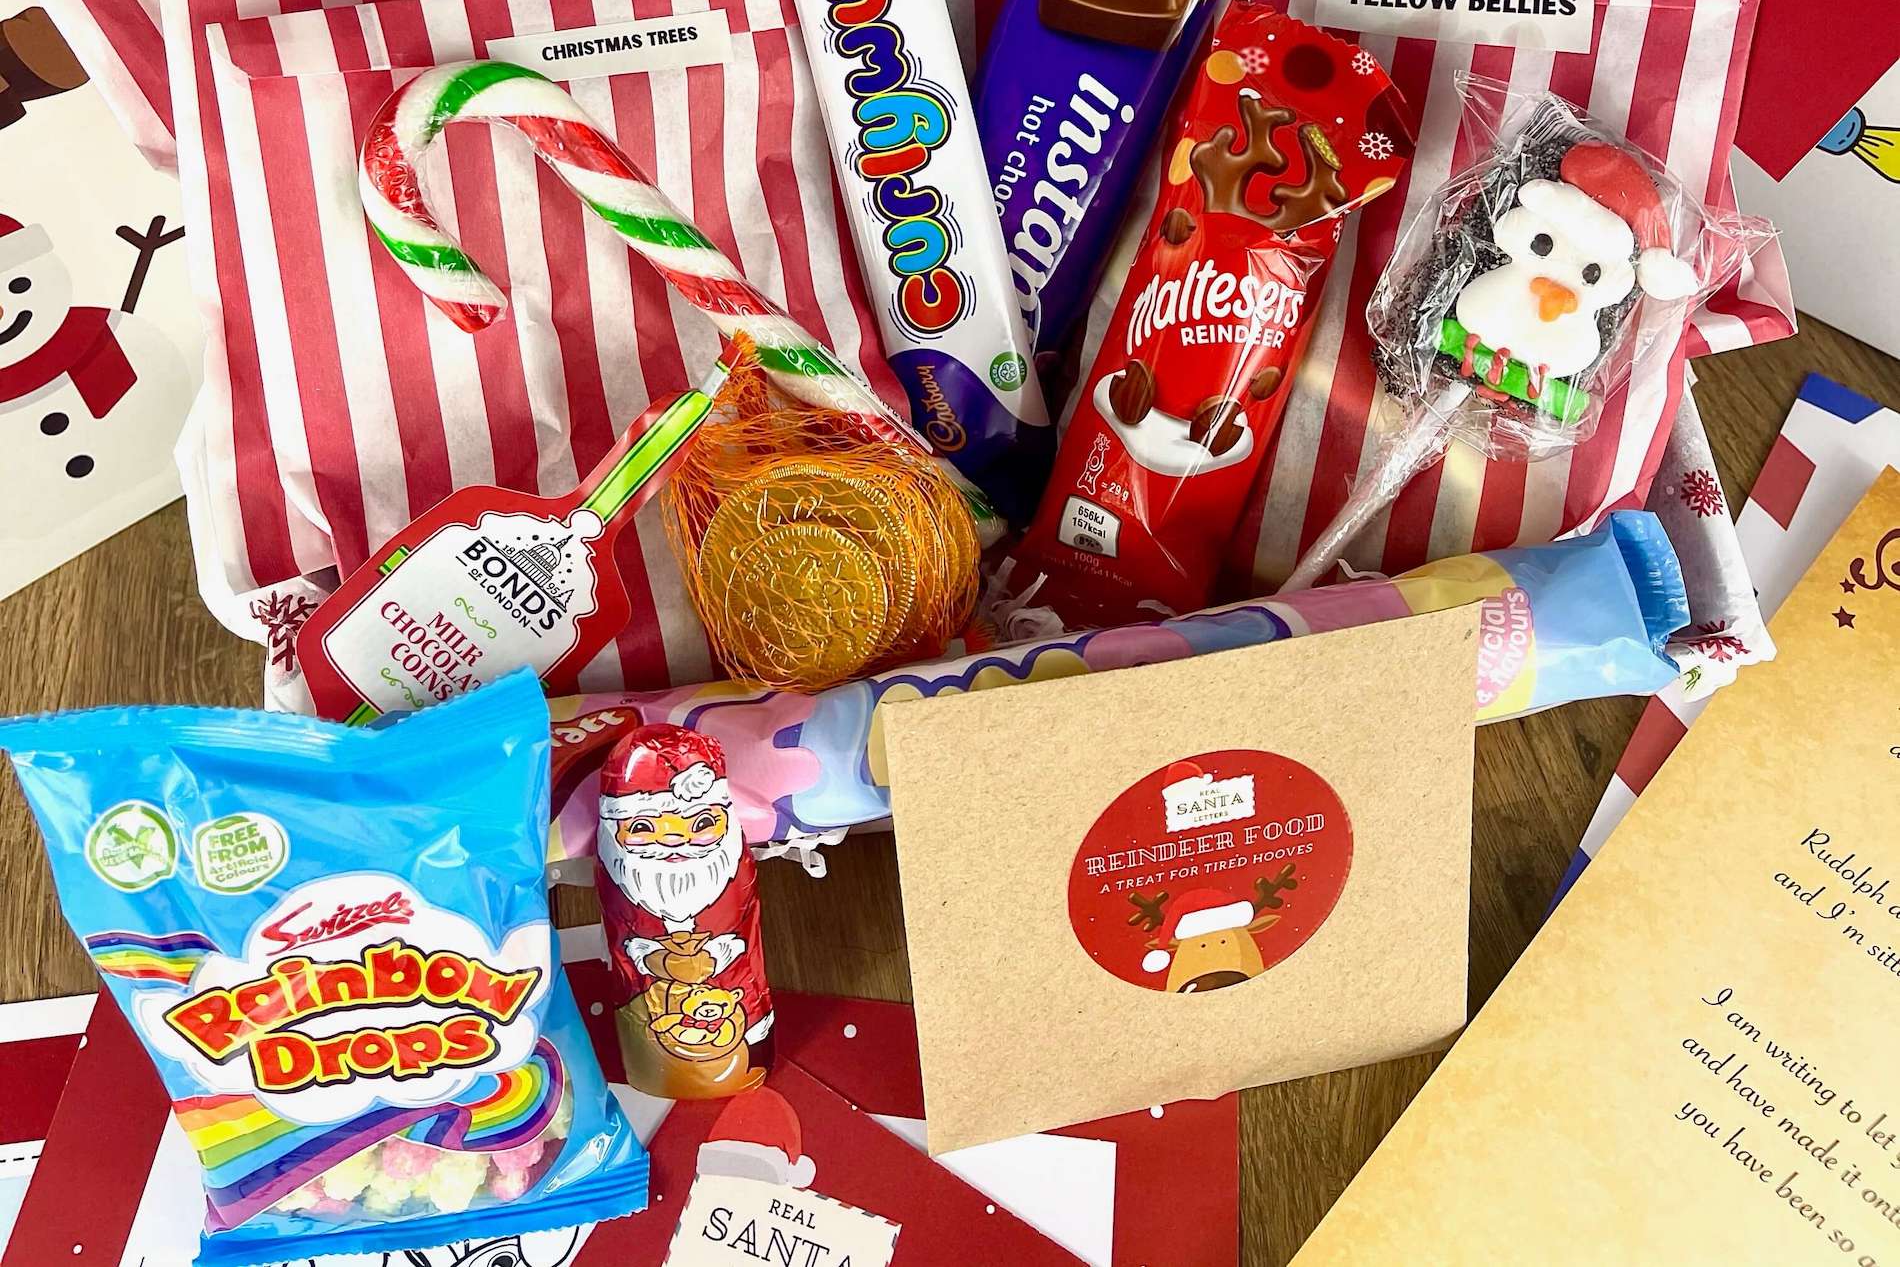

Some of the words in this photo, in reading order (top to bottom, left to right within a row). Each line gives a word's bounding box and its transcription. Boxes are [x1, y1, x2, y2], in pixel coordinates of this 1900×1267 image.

[542, 34, 642, 61] CHRISTMAS
[647, 27, 698, 46] TREES
[1016, 94, 1056, 147] hot
[1008, 72, 1135, 322] instan
[1181, 324, 1285, 349] REINDEER
[916, 365, 967, 452] Cadbury
[1084, 471, 1094, 484] 1x
[1078, 505, 1104, 525] 656kJ
[462, 539, 563, 631] BONDS
[502, 545, 515, 556] 18
[547, 582, 560, 595] 95
[471, 568, 483, 580] OF
[479, 577, 531, 628] LONDON
[427, 612, 484, 667] MILK
[390, 643, 453, 701] COINS
[1176, 792, 1244, 816] SANTA
[1193, 811, 1229, 823] LETTERS
[207, 836, 268, 863] FROM
[208, 822, 260, 847] FREE
[1085, 831, 1235, 876] REINDEER
[1244, 813, 1325, 846] FOOD
[215, 863, 270, 883] Colours
[1100, 884, 1111, 894] A
[1116, 872, 1165, 891] TREAT
[1169, 866, 1199, 880] FOR
[1204, 857, 1248, 874] TIRED
[1252, 843, 1314, 864] HOOVES
[1800, 828, 1890, 905] Rudolph
[1774, 871, 1826, 906] and
[1815, 902, 1864, 946] I'm
[165, 939, 540, 1062] Rainbow
[253, 1015, 498, 1092] Drops
[1701, 988, 1733, 1006] I
[1727, 1012, 1761, 1043] am
[1765, 1040, 1836, 1106] writing
[1839, 1099, 1862, 1123] to
[1865, 1113, 1896, 1150] let
[1682, 1038, 1736, 1075] and
[1725, 1063, 1775, 1118] have
[1777, 1118, 1840, 1170] made
[1841, 1163, 1862, 1189] it
[1674, 1102, 1720, 1139] you
[1722, 1127, 1774, 1183] have
[1775, 1171, 1825, 1229] been
[1828, 1229, 1855, 1252] so
[768, 1199, 816, 1229] REAL
